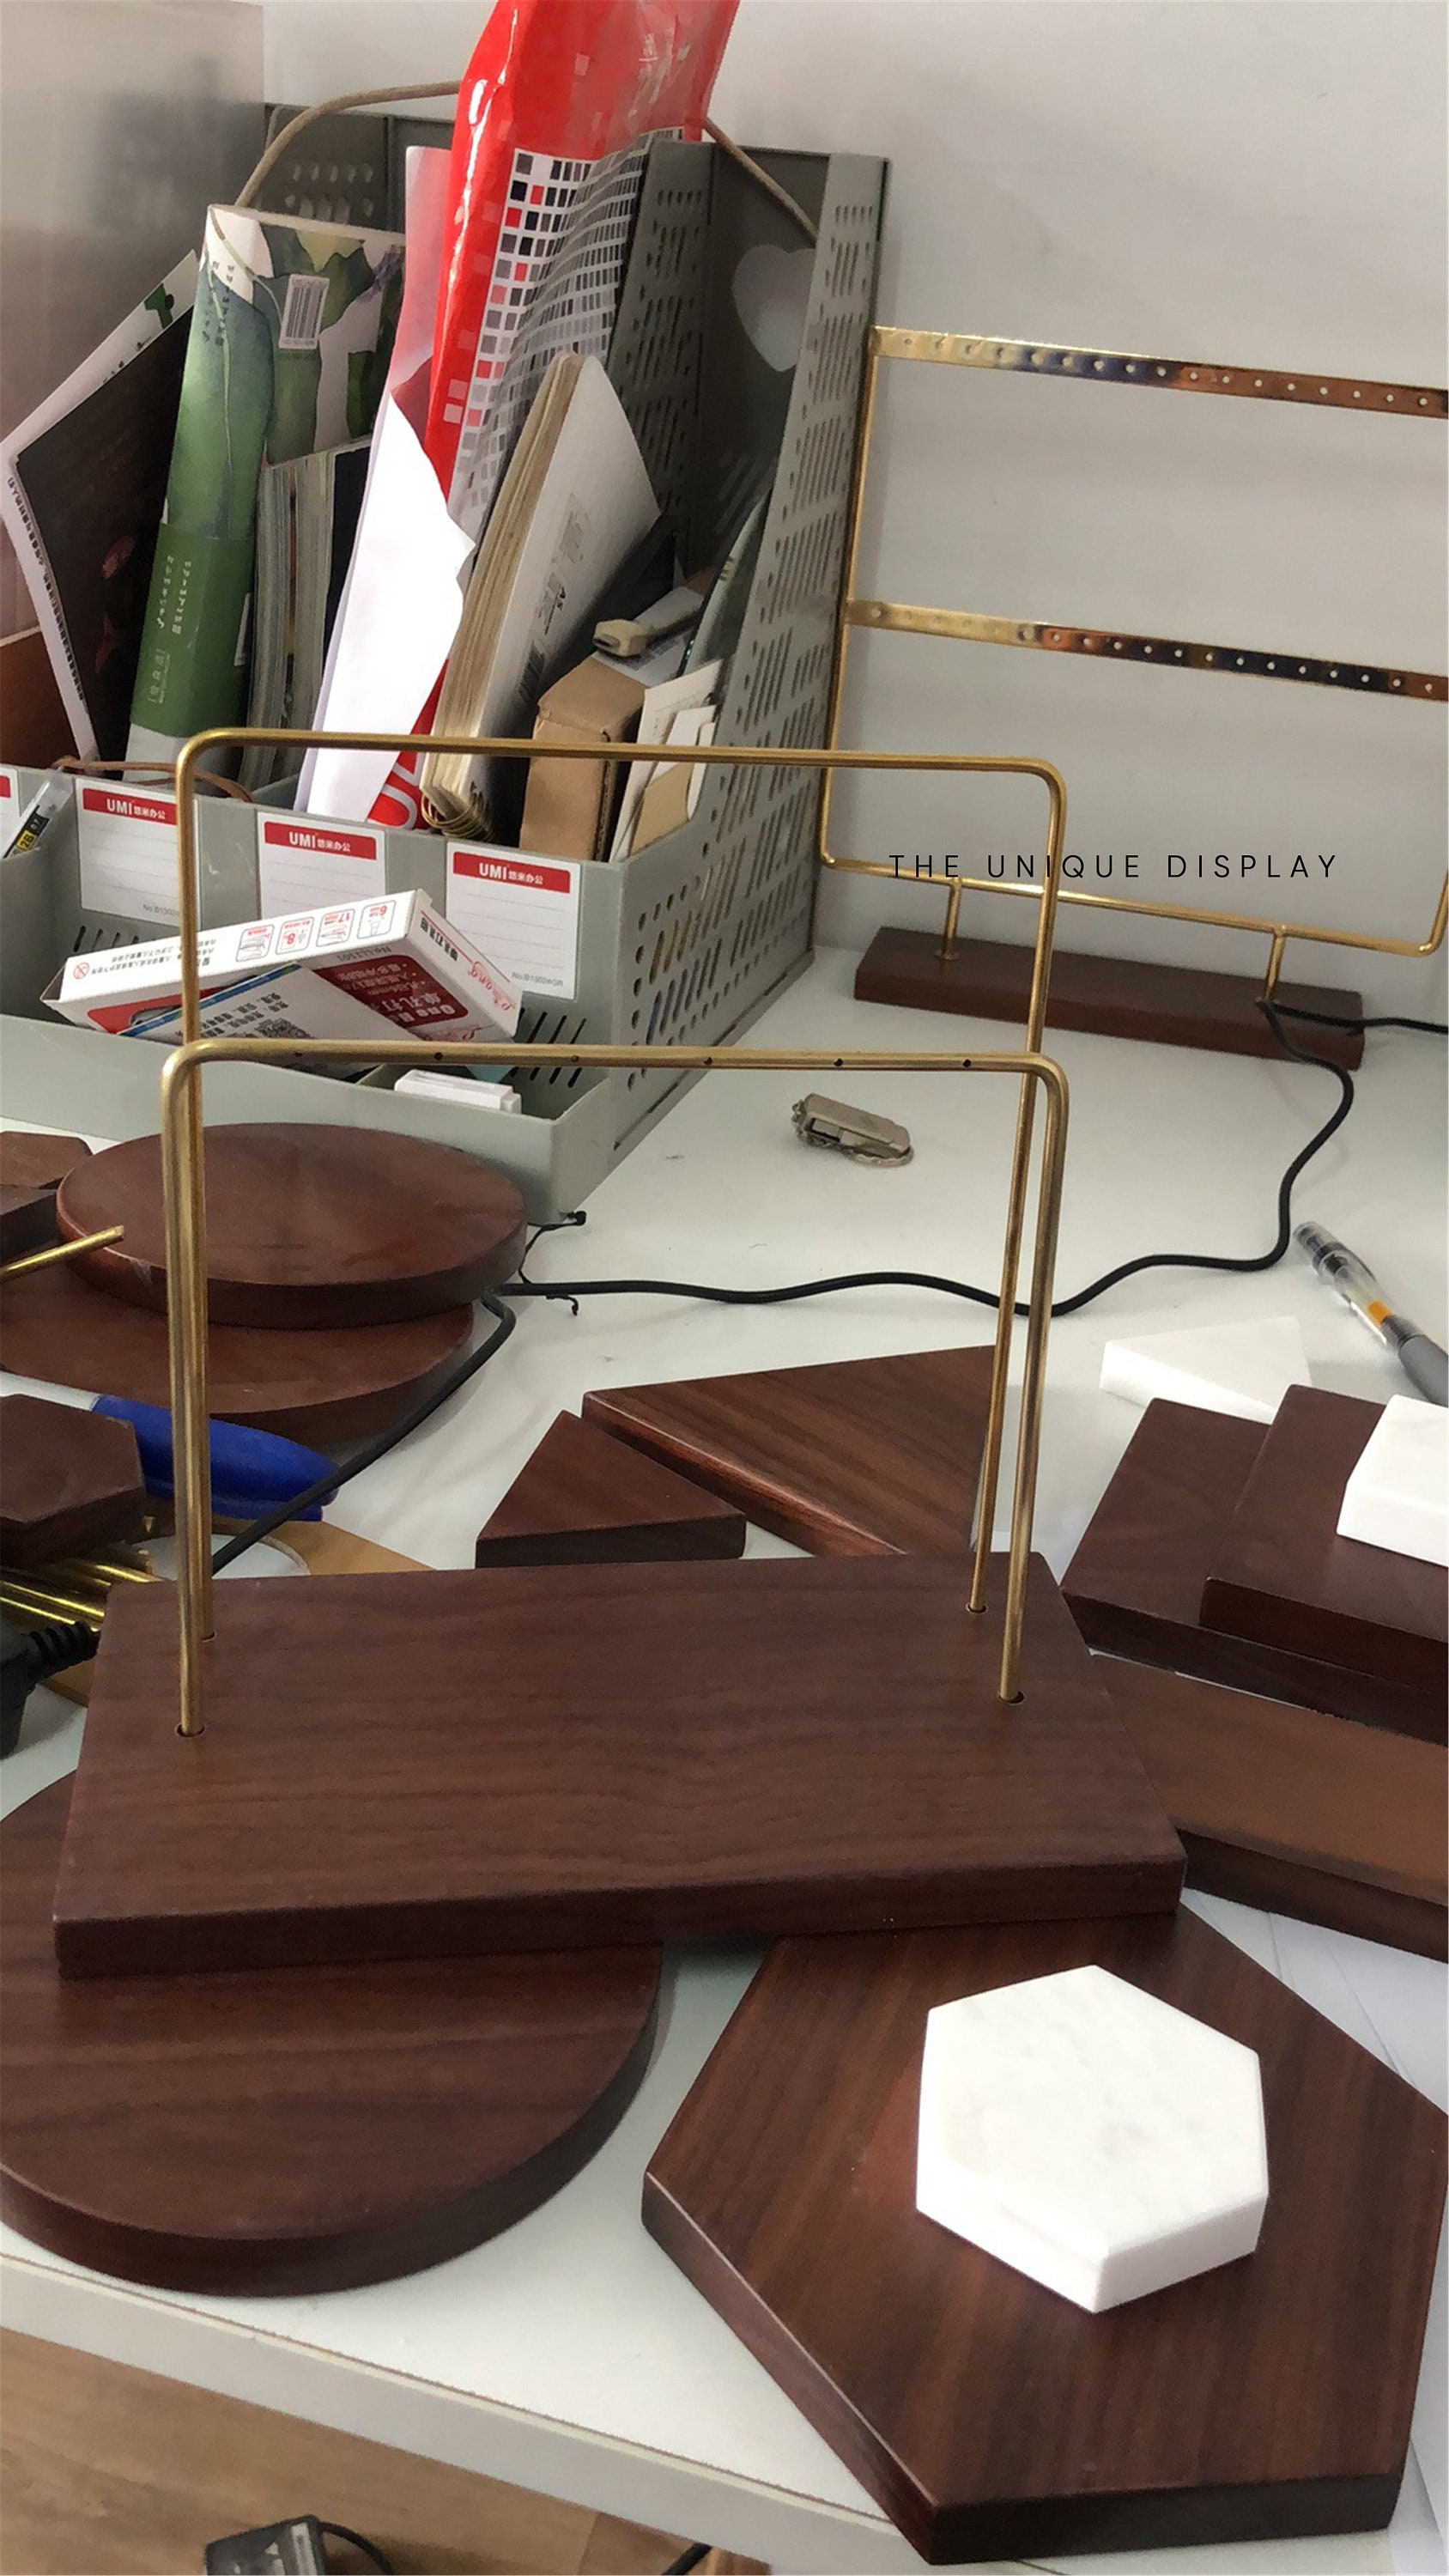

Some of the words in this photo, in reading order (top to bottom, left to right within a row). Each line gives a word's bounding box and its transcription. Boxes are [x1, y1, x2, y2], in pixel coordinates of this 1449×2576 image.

[106, 799, 132, 816] UMI
[289, 831, 316, 849] UMI
[479, 862, 507, 880] UMI
